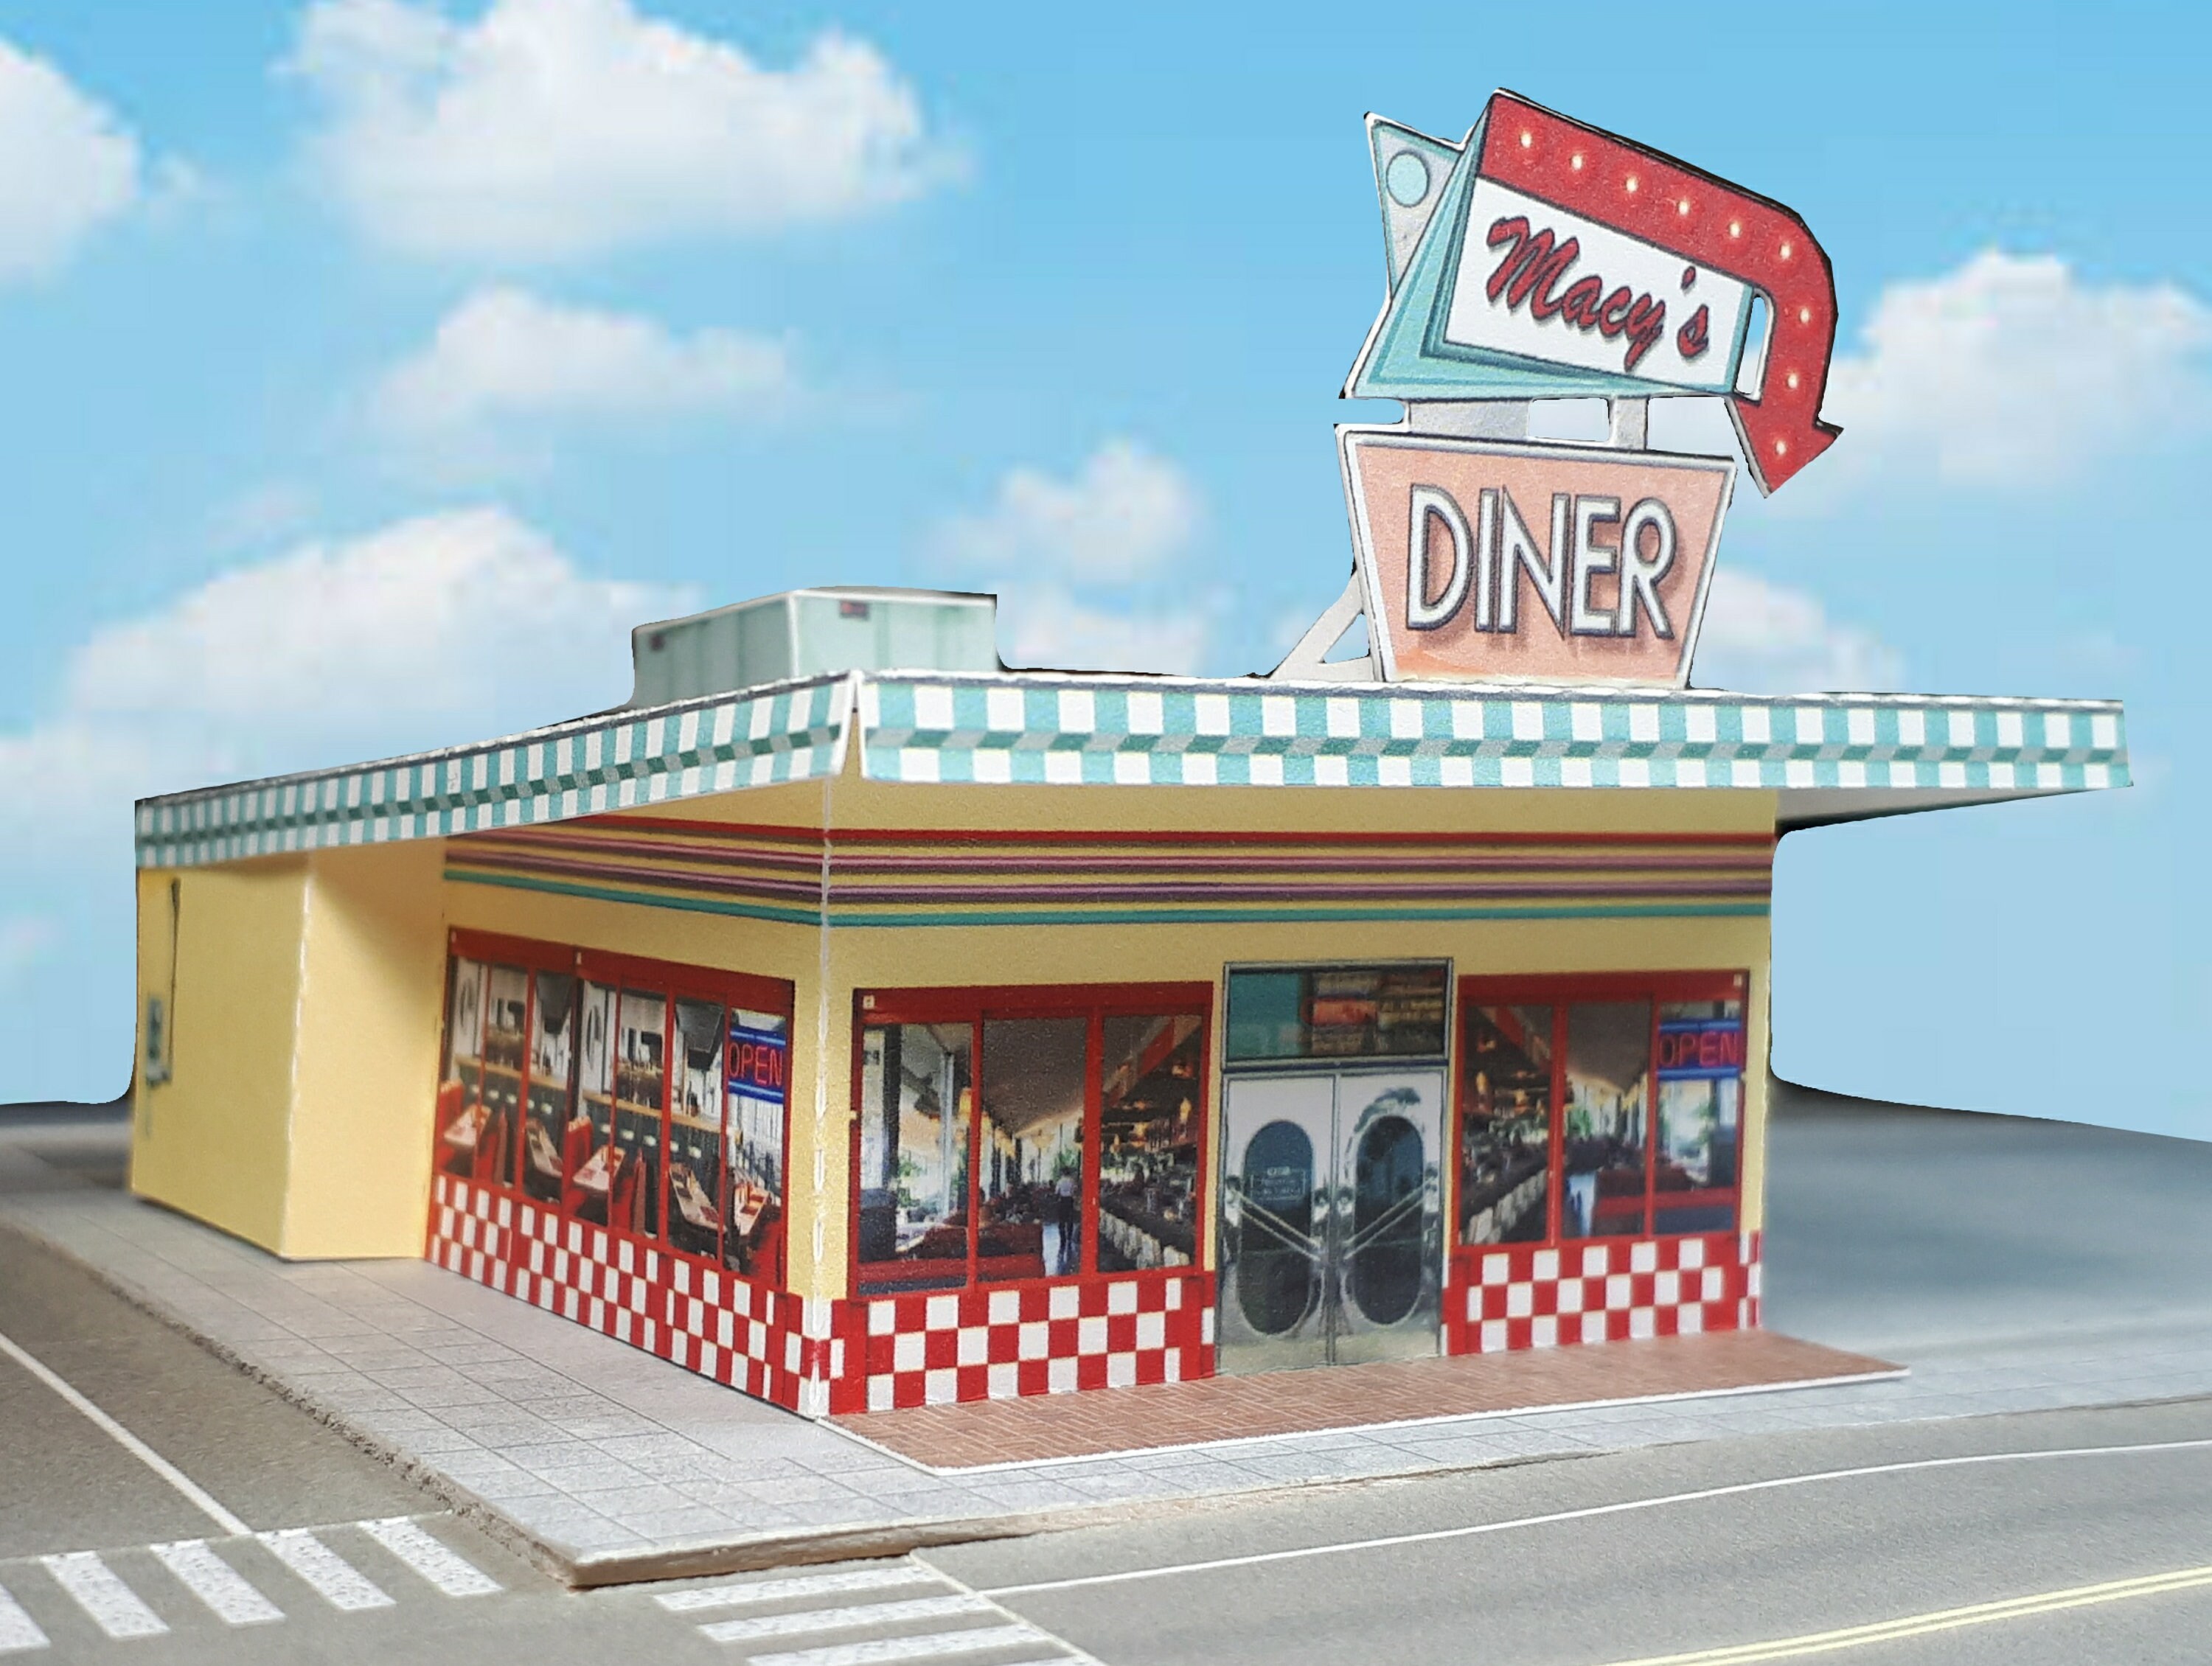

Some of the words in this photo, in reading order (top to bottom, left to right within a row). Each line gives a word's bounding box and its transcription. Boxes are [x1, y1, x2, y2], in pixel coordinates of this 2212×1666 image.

[1486, 215, 1709, 372] Macy's
[1405, 482, 1676, 640] DINER
[728, 1042, 783, 1087] OPEN
[1659, 1031, 1738, 1067] OPEN
